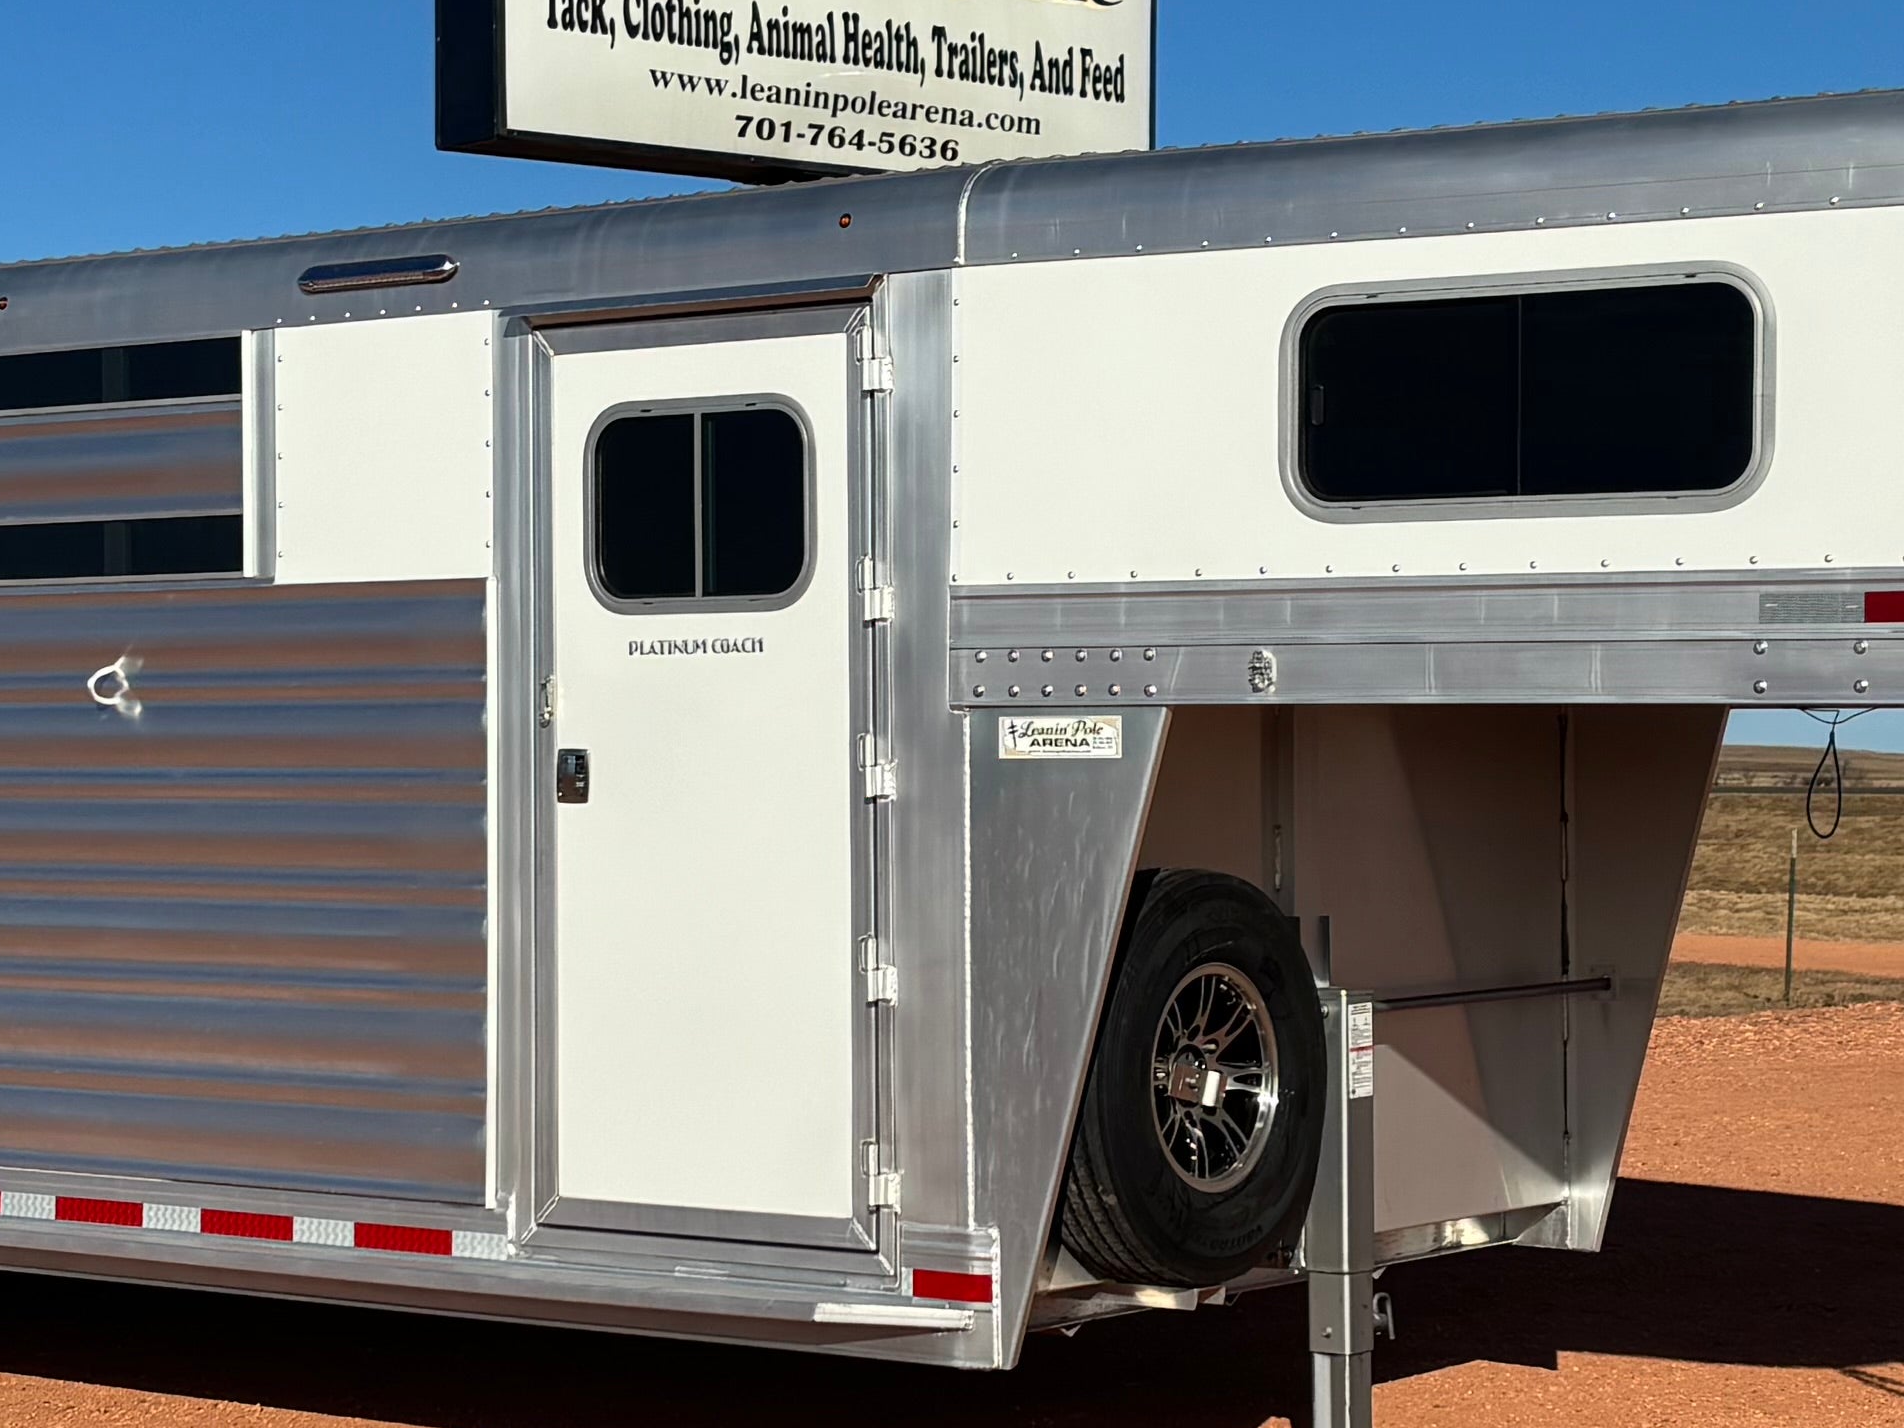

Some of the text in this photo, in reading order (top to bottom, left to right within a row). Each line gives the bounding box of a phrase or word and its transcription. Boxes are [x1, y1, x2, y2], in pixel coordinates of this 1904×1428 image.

[746, 0, 837, 64] Animal
[841, 10, 926, 88] Health,
[931, 24, 1025, 102] Trailers,
[1029, 39, 1074, 97] And
[1079, 47, 1126, 104] Feed
[648, 68, 1042, 136] www.leaninpolearena.com
[733, 114, 961, 162] 701-764-5636
[628, 636, 765, 656] PLATINUM COACH
[1029, 737, 1091, 748] ARENA
[1071, 719, 1104, 737] Pole
